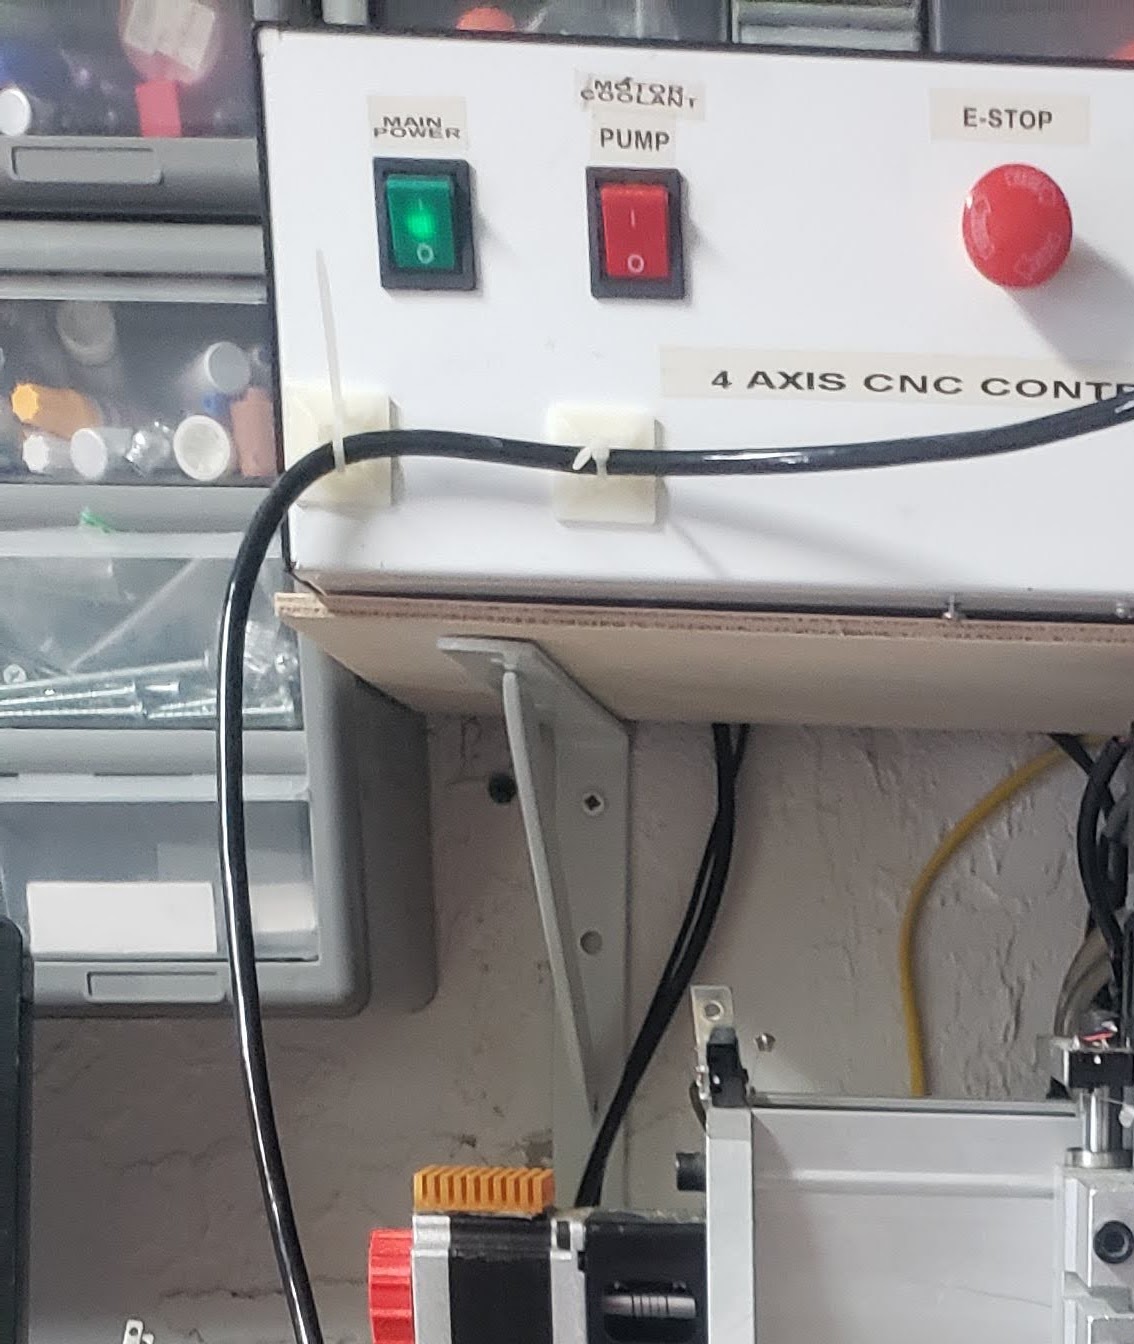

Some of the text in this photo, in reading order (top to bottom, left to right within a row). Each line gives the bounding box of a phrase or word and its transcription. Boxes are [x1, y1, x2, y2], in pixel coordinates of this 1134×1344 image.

[580, 89, 698, 109] COOLANT
[383, 117, 441, 128] MAIN
[963, 106, 1053, 130] E-STOP
[374, 127, 461, 139] POWER
[600, 128, 670, 151] PUMP
[711, 371, 732, 389] 4
[747, 371, 846, 392] AXIS
[863, 372, 964, 396] CNC
